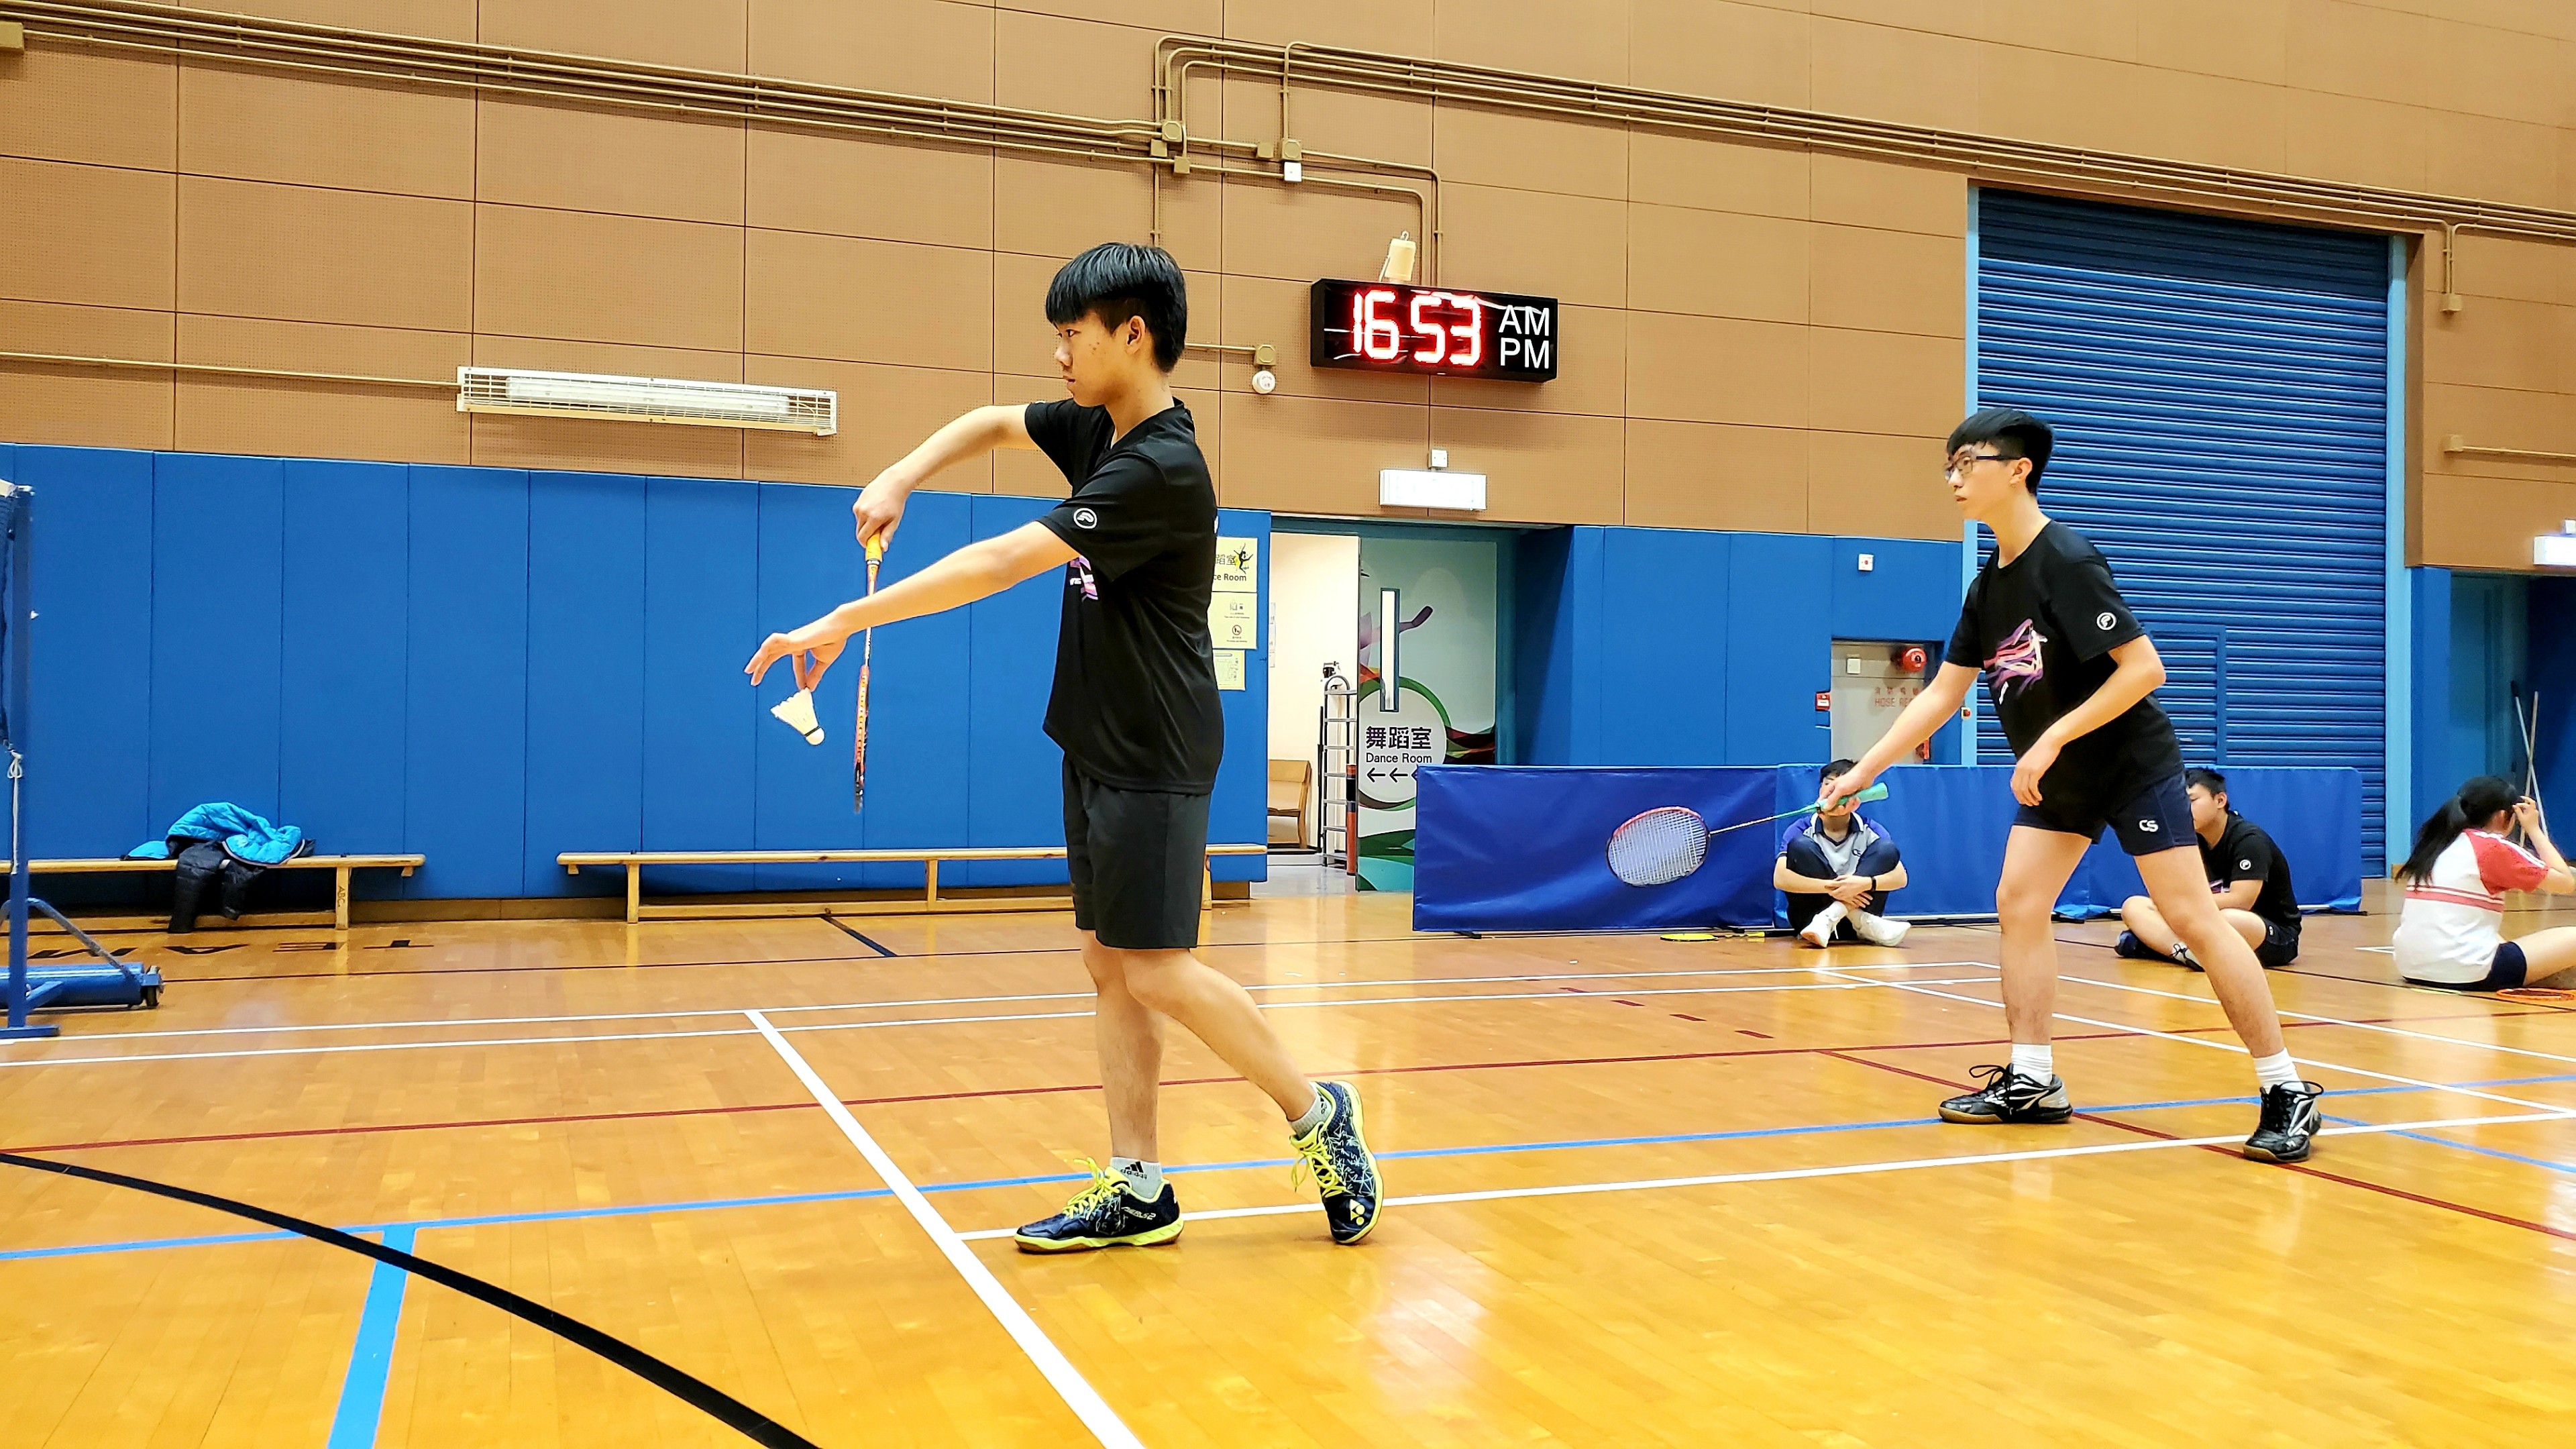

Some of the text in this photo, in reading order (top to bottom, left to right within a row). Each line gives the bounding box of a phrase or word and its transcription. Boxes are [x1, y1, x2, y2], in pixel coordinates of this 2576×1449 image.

[1499, 305, 1550, 337] AM
[1500, 337, 1550, 369] PM
[1224, 573, 1246, 581] Room
[1366, 726, 1432, 749] 舞蹈室
[1366, 752, 1432, 763] Dance Room
[337, 885, 345, 908] ABC
